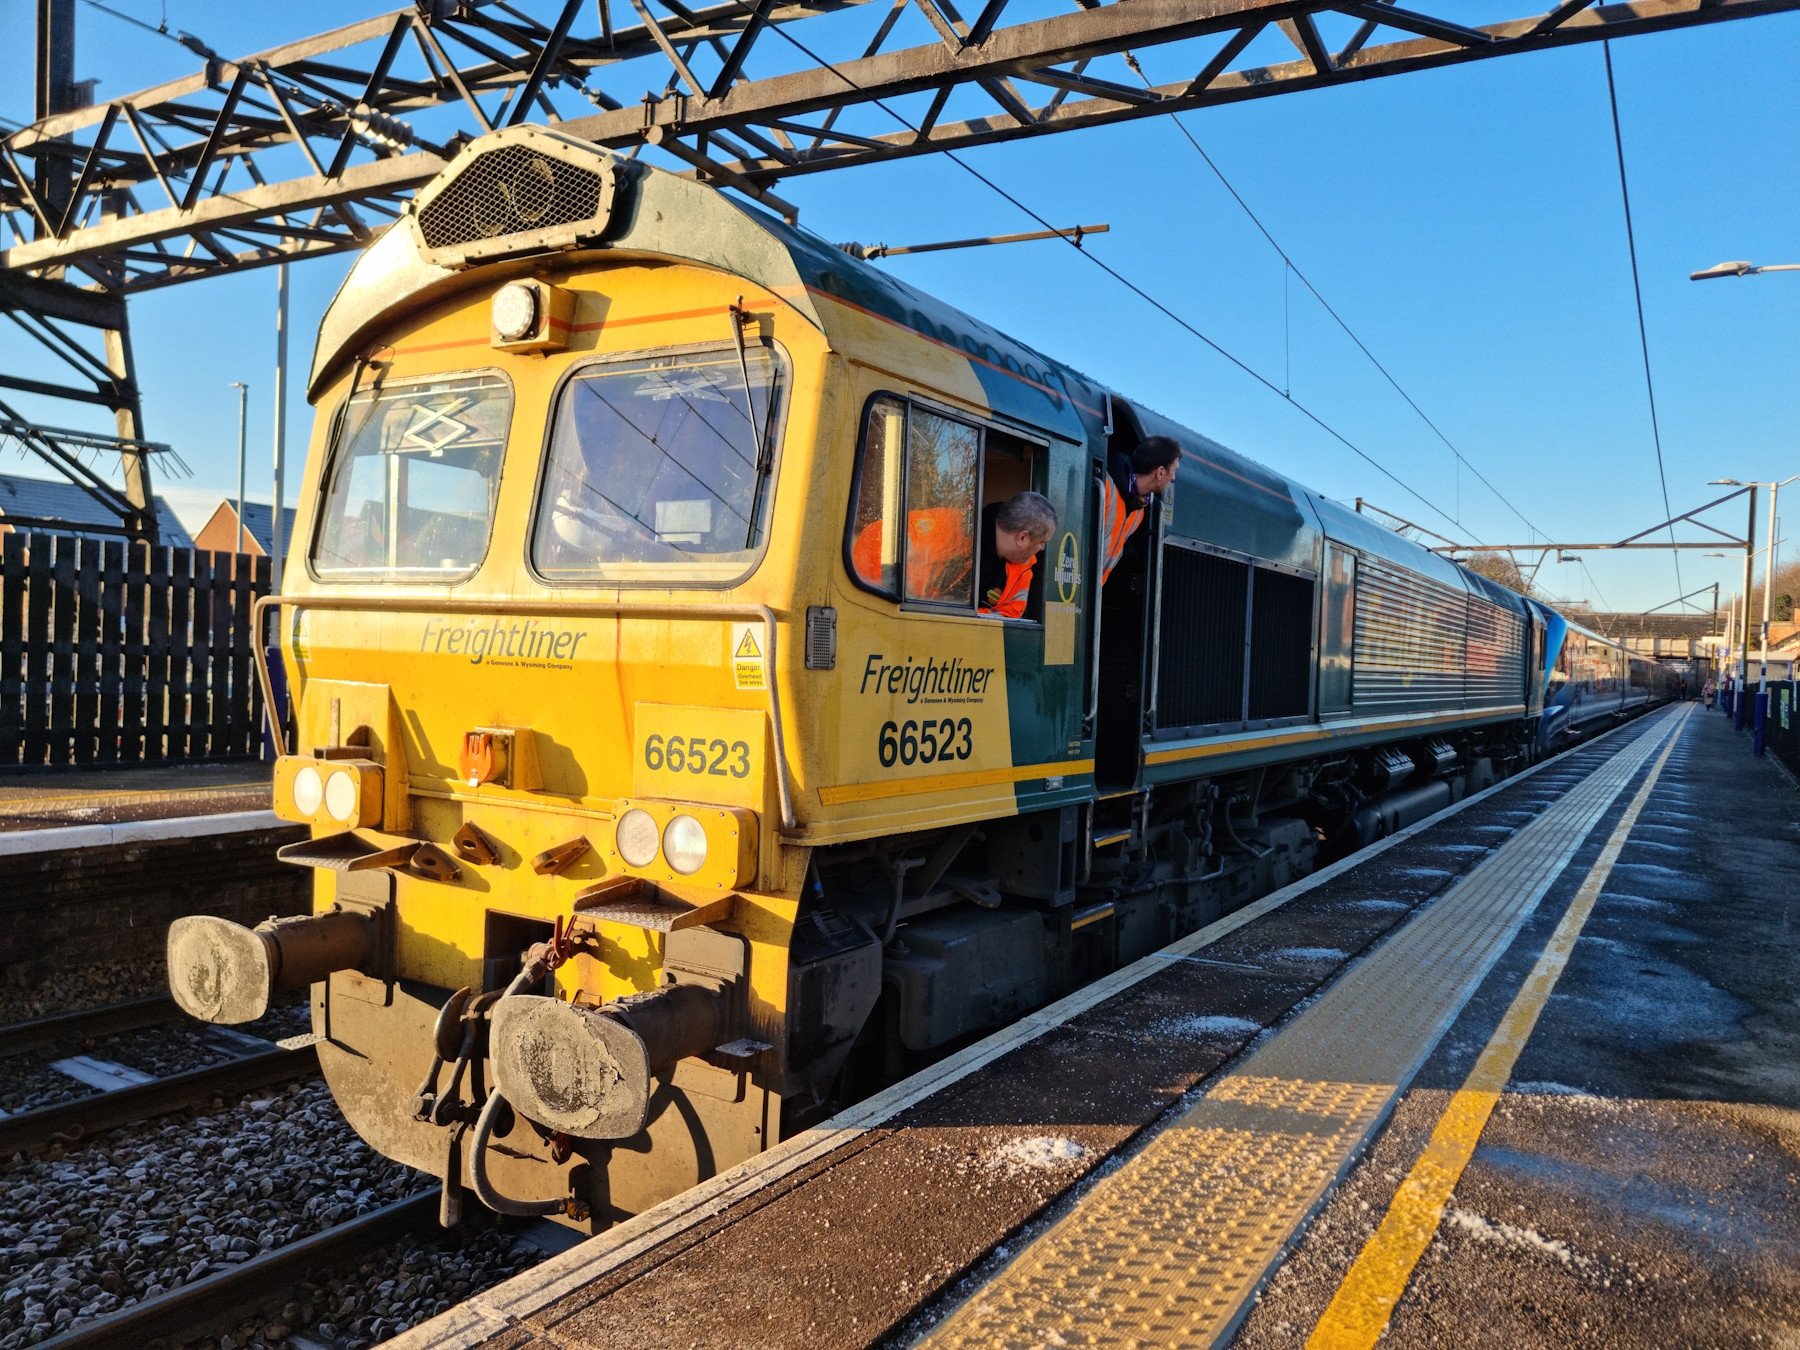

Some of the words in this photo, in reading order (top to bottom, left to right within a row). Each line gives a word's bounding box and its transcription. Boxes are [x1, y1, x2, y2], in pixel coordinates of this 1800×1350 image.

[1054, 567, 1081, 584] Injuries
[1061, 553, 1076, 568] Zero
[420, 618, 587, 664] Freightliner
[491, 659, 514, 667] Genesee
[521, 661, 546, 669] Wyoming
[547, 662, 573, 671] Company
[737, 664, 761, 672] Danger
[860, 654, 995, 704] Freightliner
[645, 734, 750, 778] 66523
[879, 718, 973, 768] 66523
